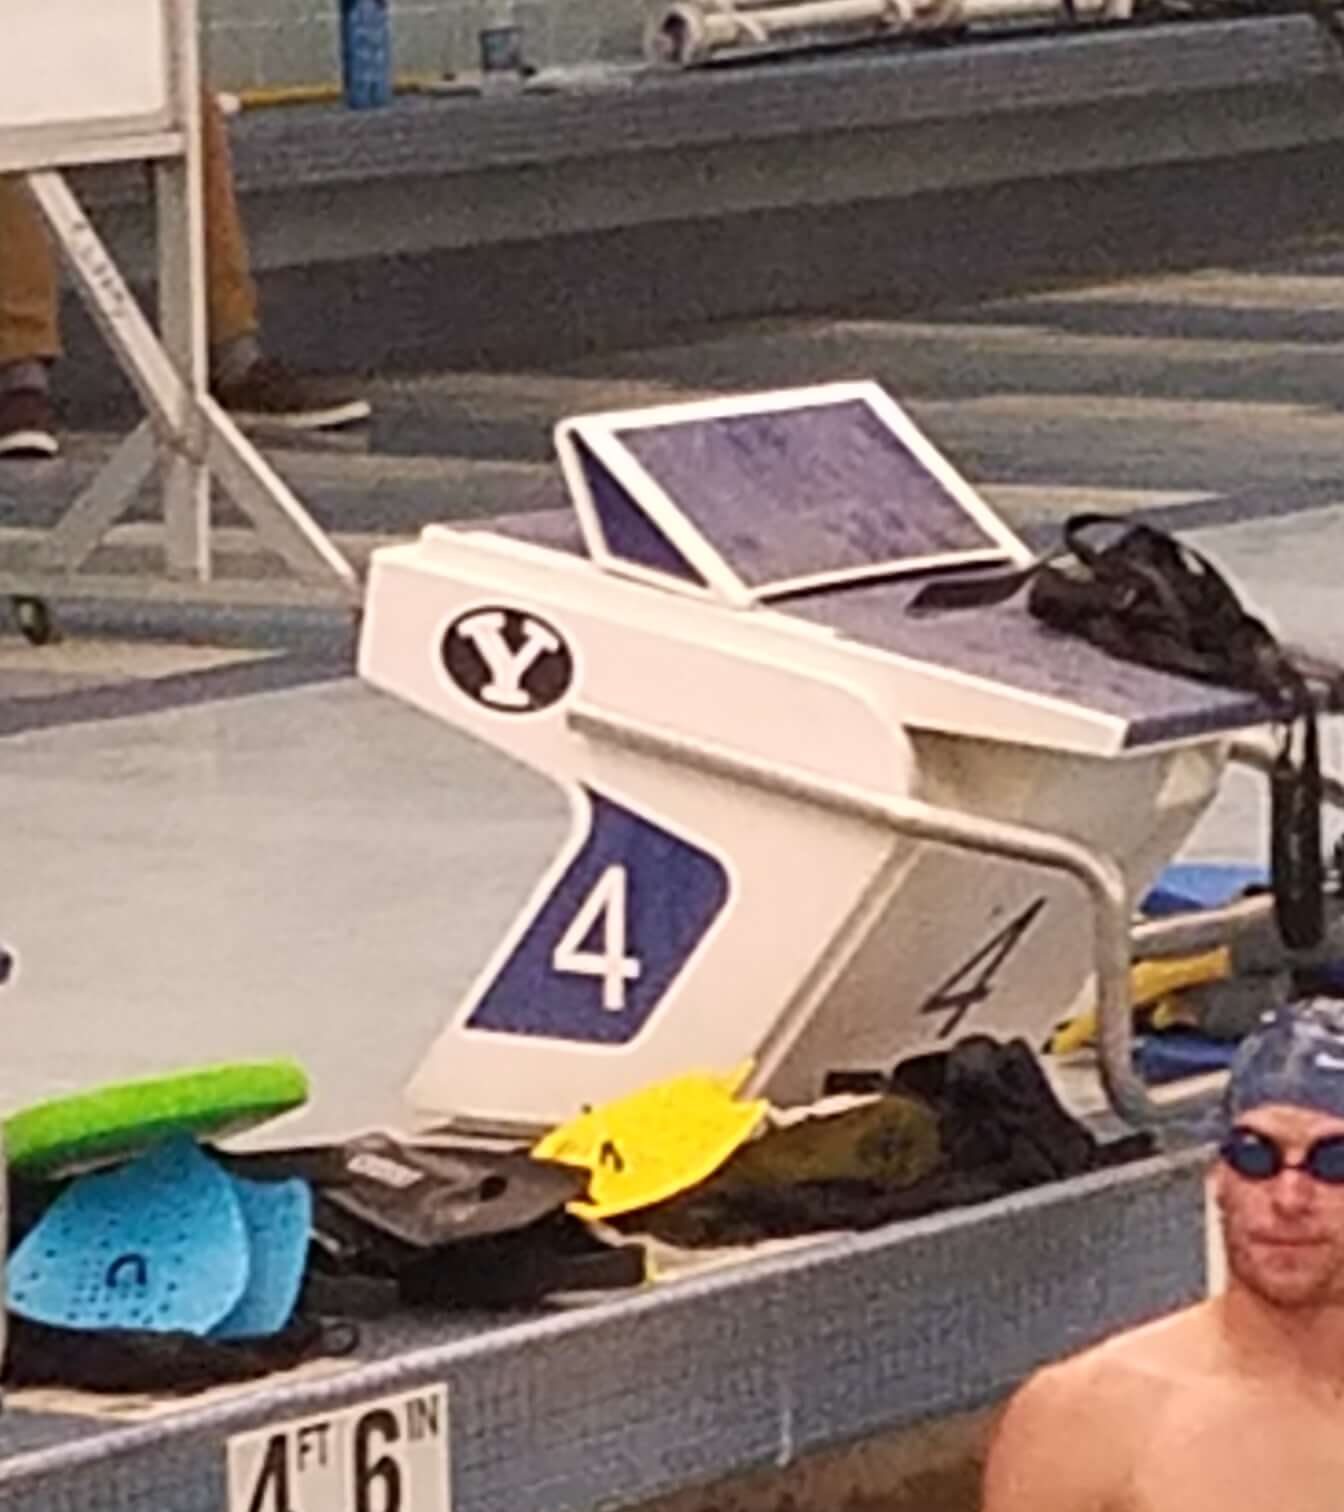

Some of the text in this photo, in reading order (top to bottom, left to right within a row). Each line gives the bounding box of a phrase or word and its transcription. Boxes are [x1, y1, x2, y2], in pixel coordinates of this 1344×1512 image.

[457, 612, 560, 707] Y
[552, 864, 640, 1013] 4
[918, 897, 1046, 1038] 4
